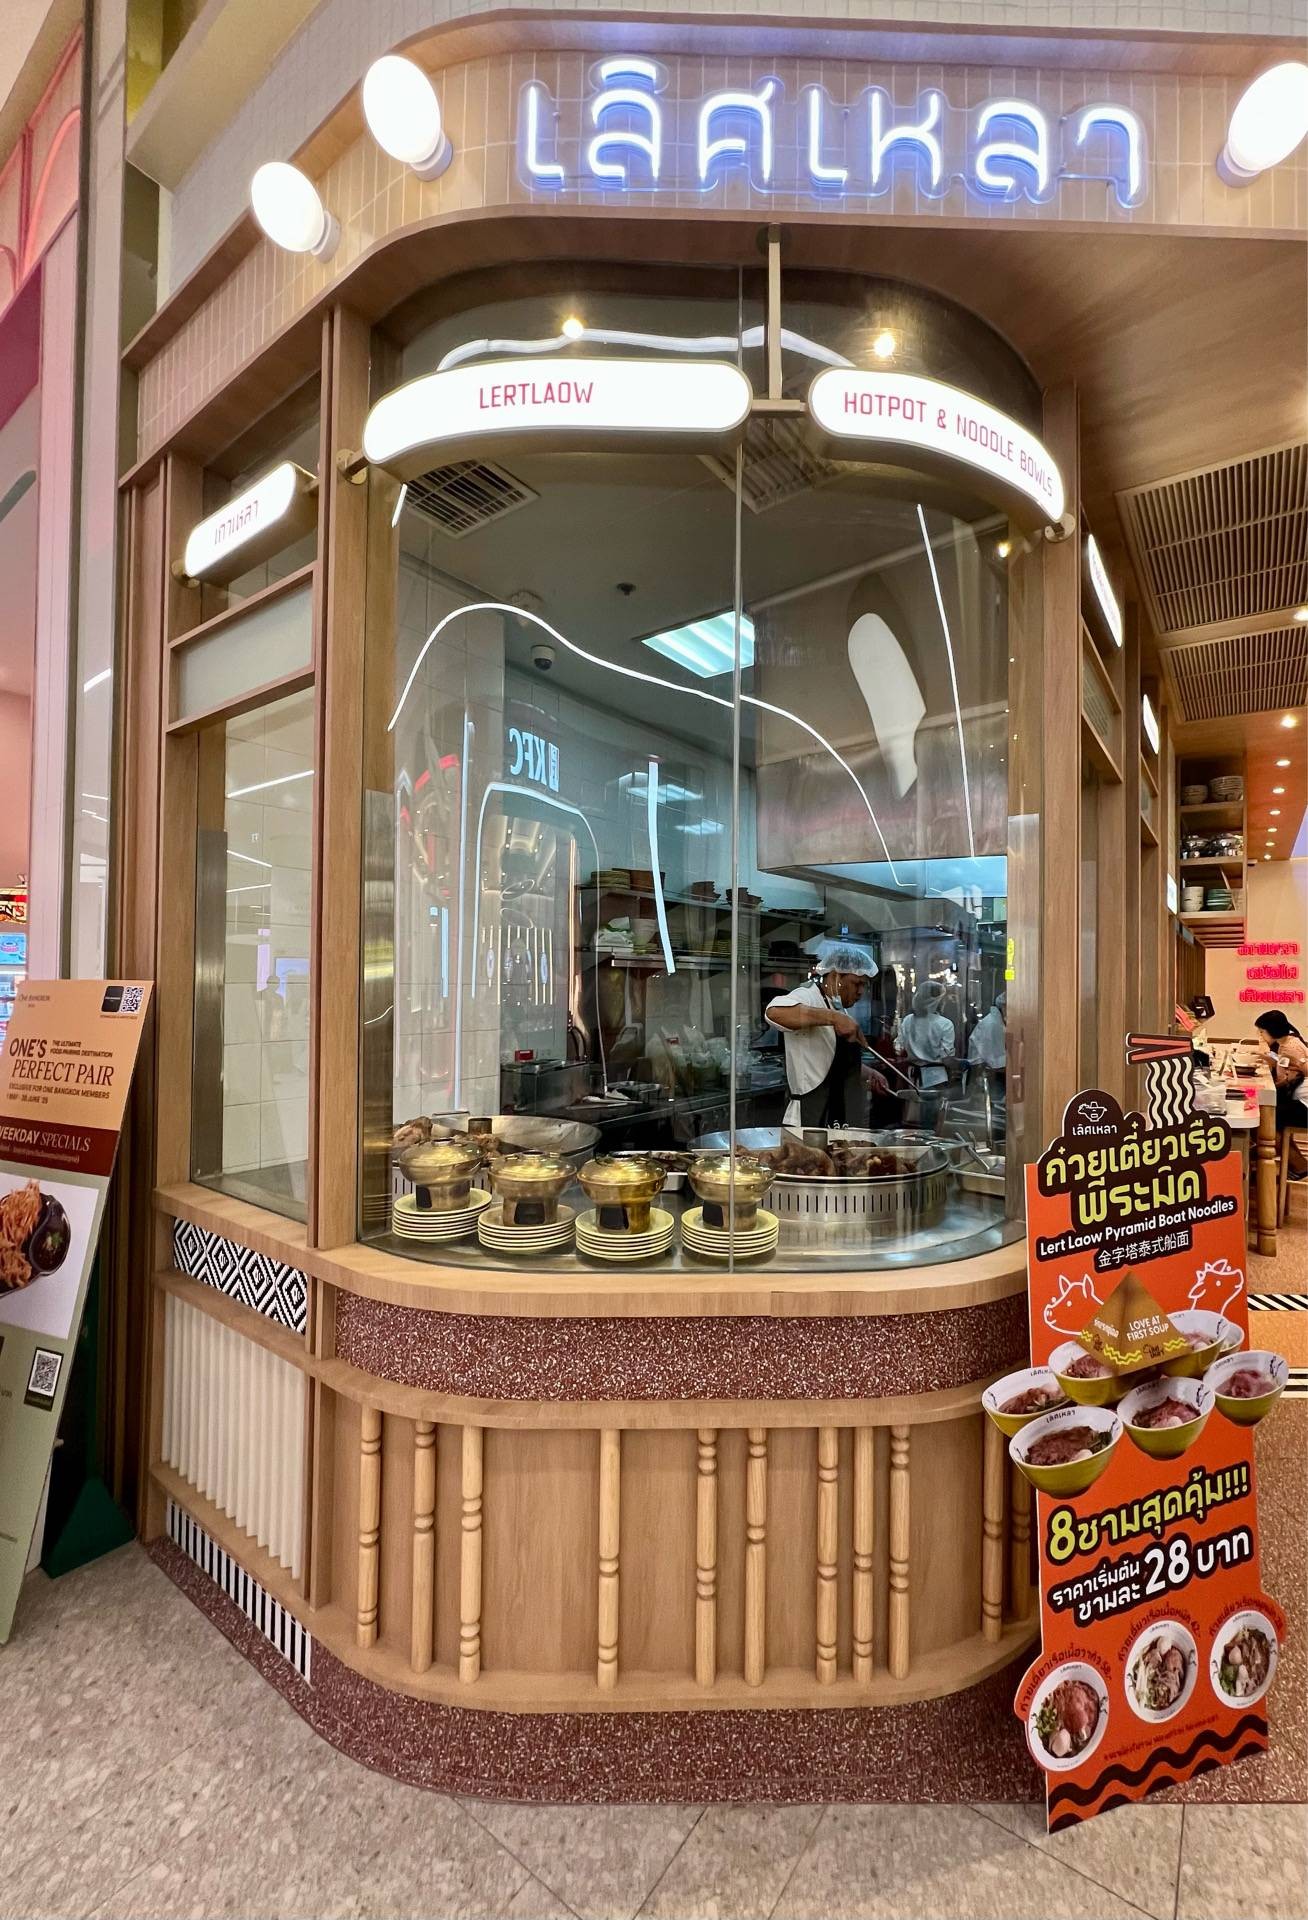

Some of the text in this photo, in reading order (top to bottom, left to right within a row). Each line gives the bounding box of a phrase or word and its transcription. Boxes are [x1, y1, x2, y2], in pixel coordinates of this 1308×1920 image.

[527, 58, 1140, 200] เลิศเหลา
[479, 382, 594, 409] LERTLAOW
[844, 391, 1053, 497] HOTPOT & NOODLE BOWLS
[9, 1038, 47, 1058] ONE'S
[12, 1059, 114, 1086] PERFECT PAIR
[54, 1087, 81, 1096] BANGKOK
[81, 1089, 110, 1099] MEMBERS
[40, 1132, 91, 1152] SPECIALS
[1072, 1123, 1118, 1136] เลิศเหลา
[1079, 1166, 1200, 1225] พีระมิด
[1040, 1199, 1234, 1256] Lert Laow Pyramid Boat Noodles
[1098, 1230, 1190, 1267] 金字塔泰式船面
[1127, 1323, 1169, 1342] FIRST SOUP
[1129, 1318, 1151, 1331] LOVE
[1052, 1560, 1140, 1606] ราคาเริ่มต้น
[1078, 1531, 1250, 1621] ชามละ 28 บาท
